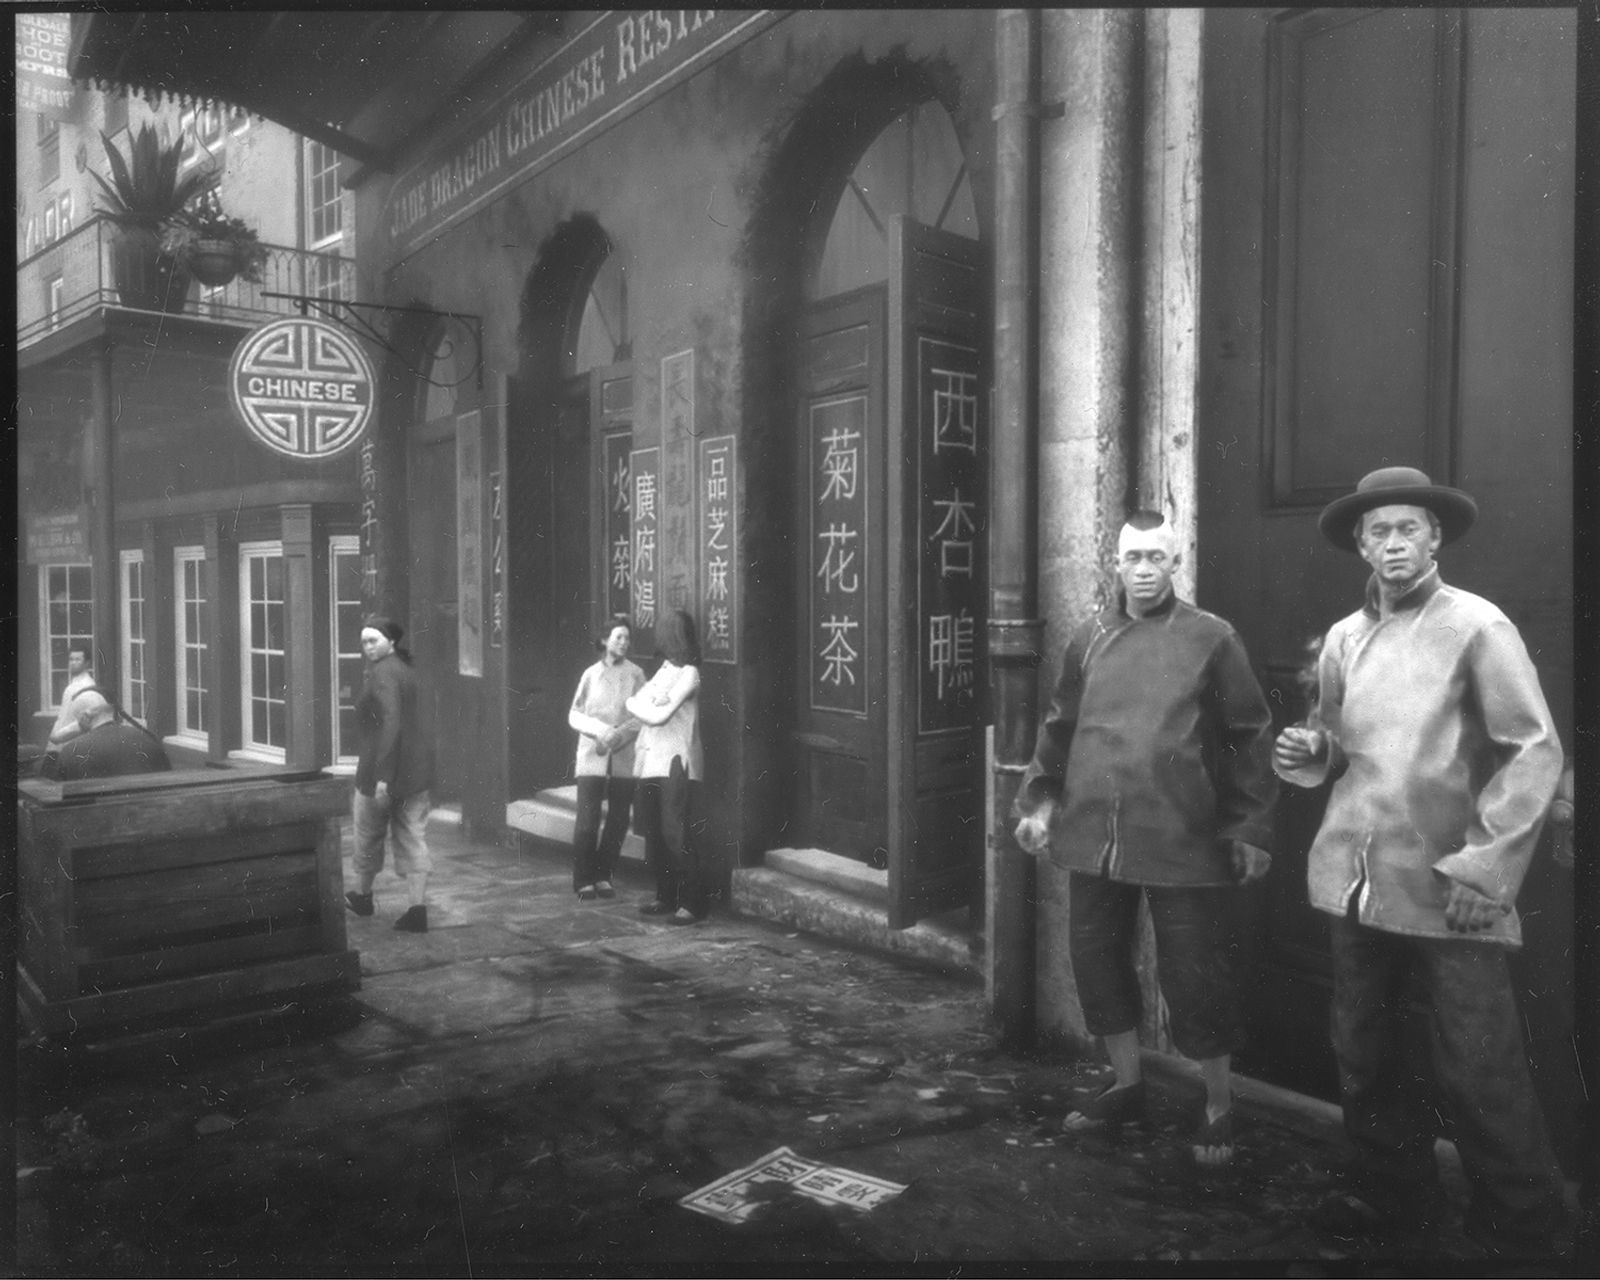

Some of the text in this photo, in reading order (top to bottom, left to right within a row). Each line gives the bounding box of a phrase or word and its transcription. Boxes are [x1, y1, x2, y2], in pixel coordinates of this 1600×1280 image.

[390, 180, 427, 238] JADE
[430, 122, 500, 209] DRAGON
[506, 46, 605, 158] CHINESE
[247, 375, 358, 403] CHINESE
[816, 427, 862, 687] 菊花茶
[928, 366, 978, 701] 西杏鴨
